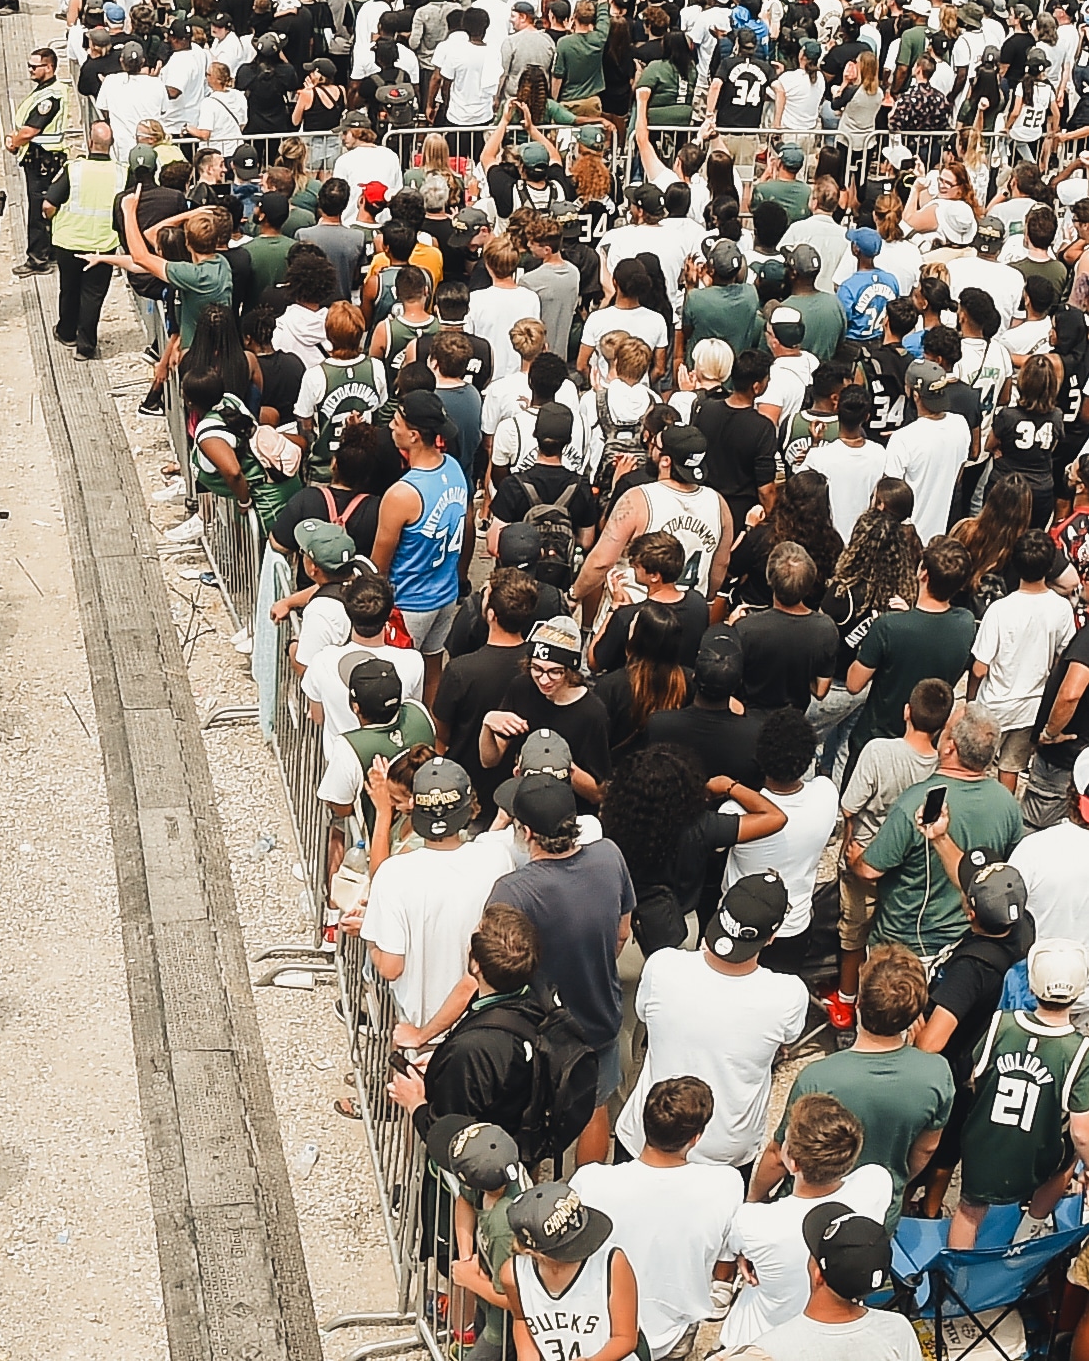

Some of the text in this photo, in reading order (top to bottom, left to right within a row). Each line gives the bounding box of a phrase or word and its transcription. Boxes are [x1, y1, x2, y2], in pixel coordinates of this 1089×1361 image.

[732, 80, 761, 106] 34
[1023, 109, 1043, 128] 22
[578, 213, 608, 243] 34
[870, 396, 905, 428] 34
[1015, 420, 1054, 450] 34
[432, 516, 466, 568] 34
[662, 516, 717, 553] TOKOUNMPO
[533, 642, 550, 660] KC
[416, 789, 461, 807] CHAMPIONS
[996, 1051, 1054, 1085] HOLIDAY
[991, 1075, 1041, 1132] 21
[543, 1191, 580, 1236] CHAMP
[525, 1312, 600, 1335] BUCKS
